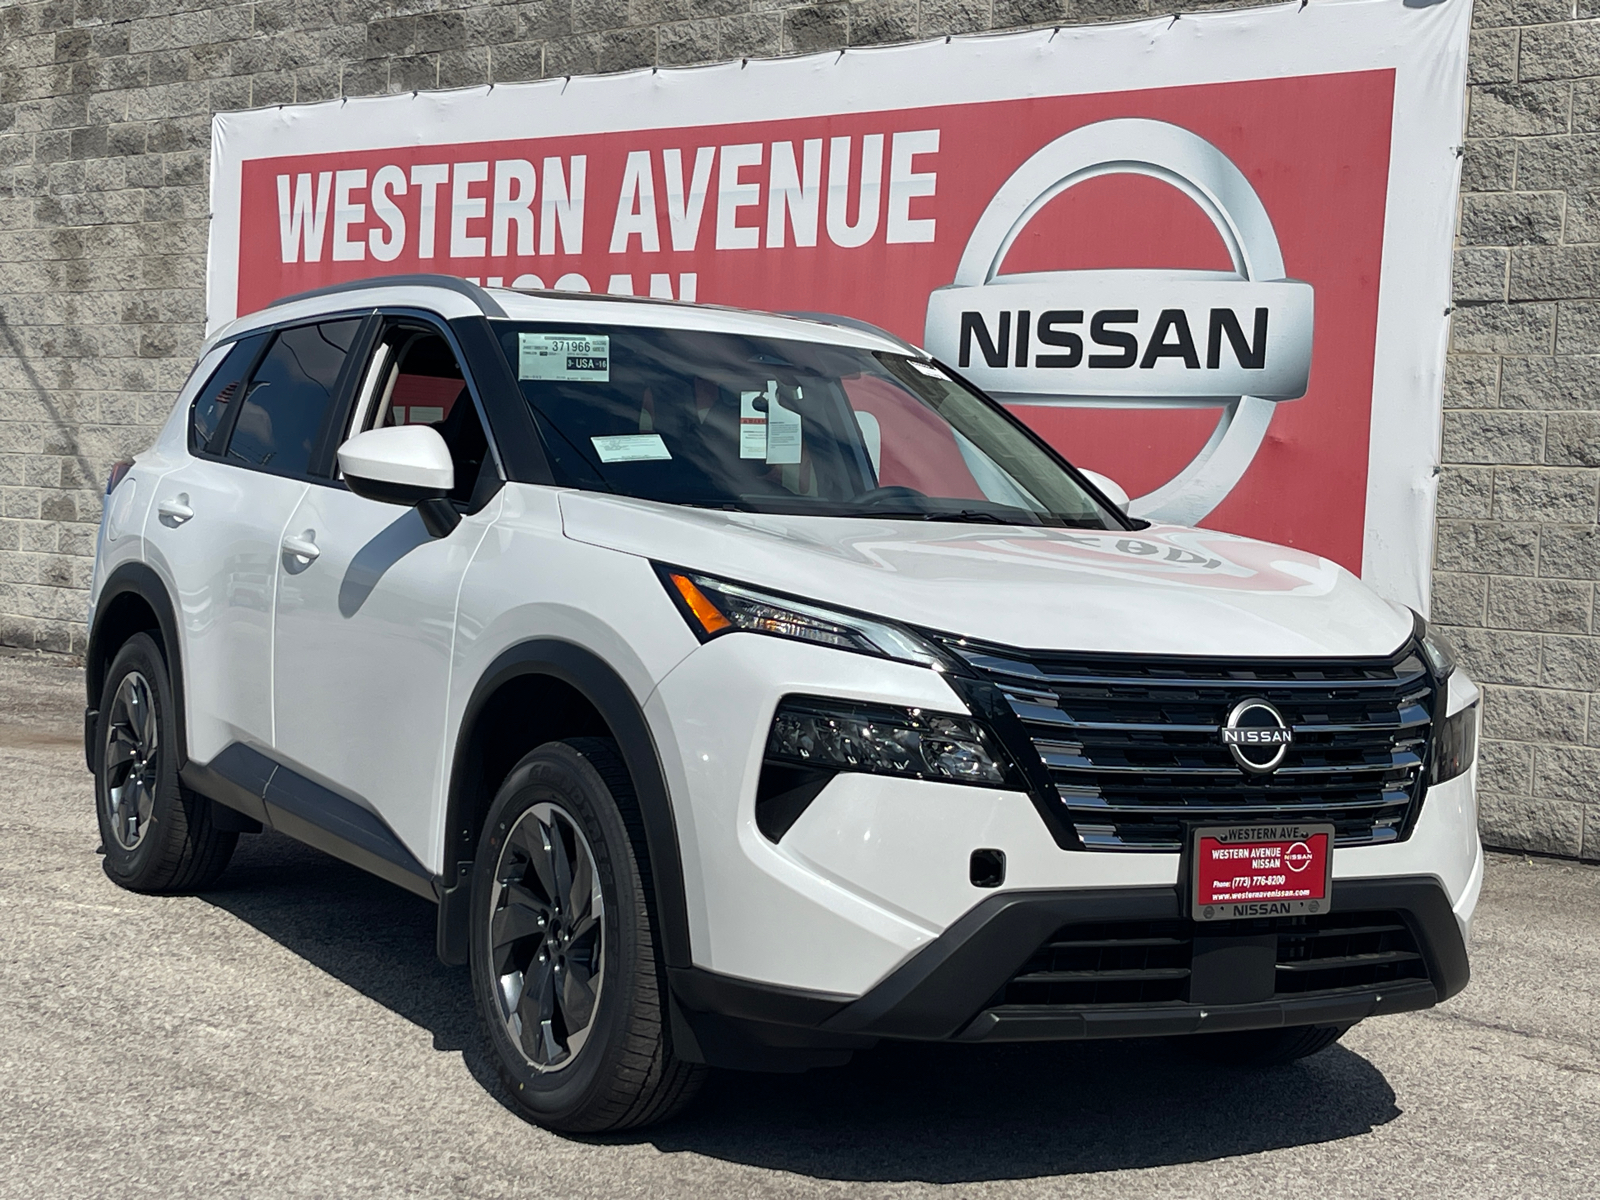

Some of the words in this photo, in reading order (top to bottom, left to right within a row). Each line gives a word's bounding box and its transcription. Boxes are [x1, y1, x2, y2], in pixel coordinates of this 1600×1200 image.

[276, 154, 588, 264] WESTERN
[609, 129, 941, 255] AVENUE
[958, 307, 1269, 369] NISSAN
[552, 341, 591, 352] 371966
[1224, 731, 1292, 742] NISSAN
[1228, 828, 1277, 840] WESTERN
[1212, 849, 1249, 860] WESTERN
[1250, 847, 1281, 858] AVENUE
[1252, 859, 1280, 869] NISSAN
[1213, 880, 1231, 888] Phone:
[1232, 876, 1250, 889] (773)
[1252, 875, 1286, 886] 776-8200
[1212, 889, 1310, 900] www.westernavenissan.com
[1233, 903, 1291, 917] NISSAN
